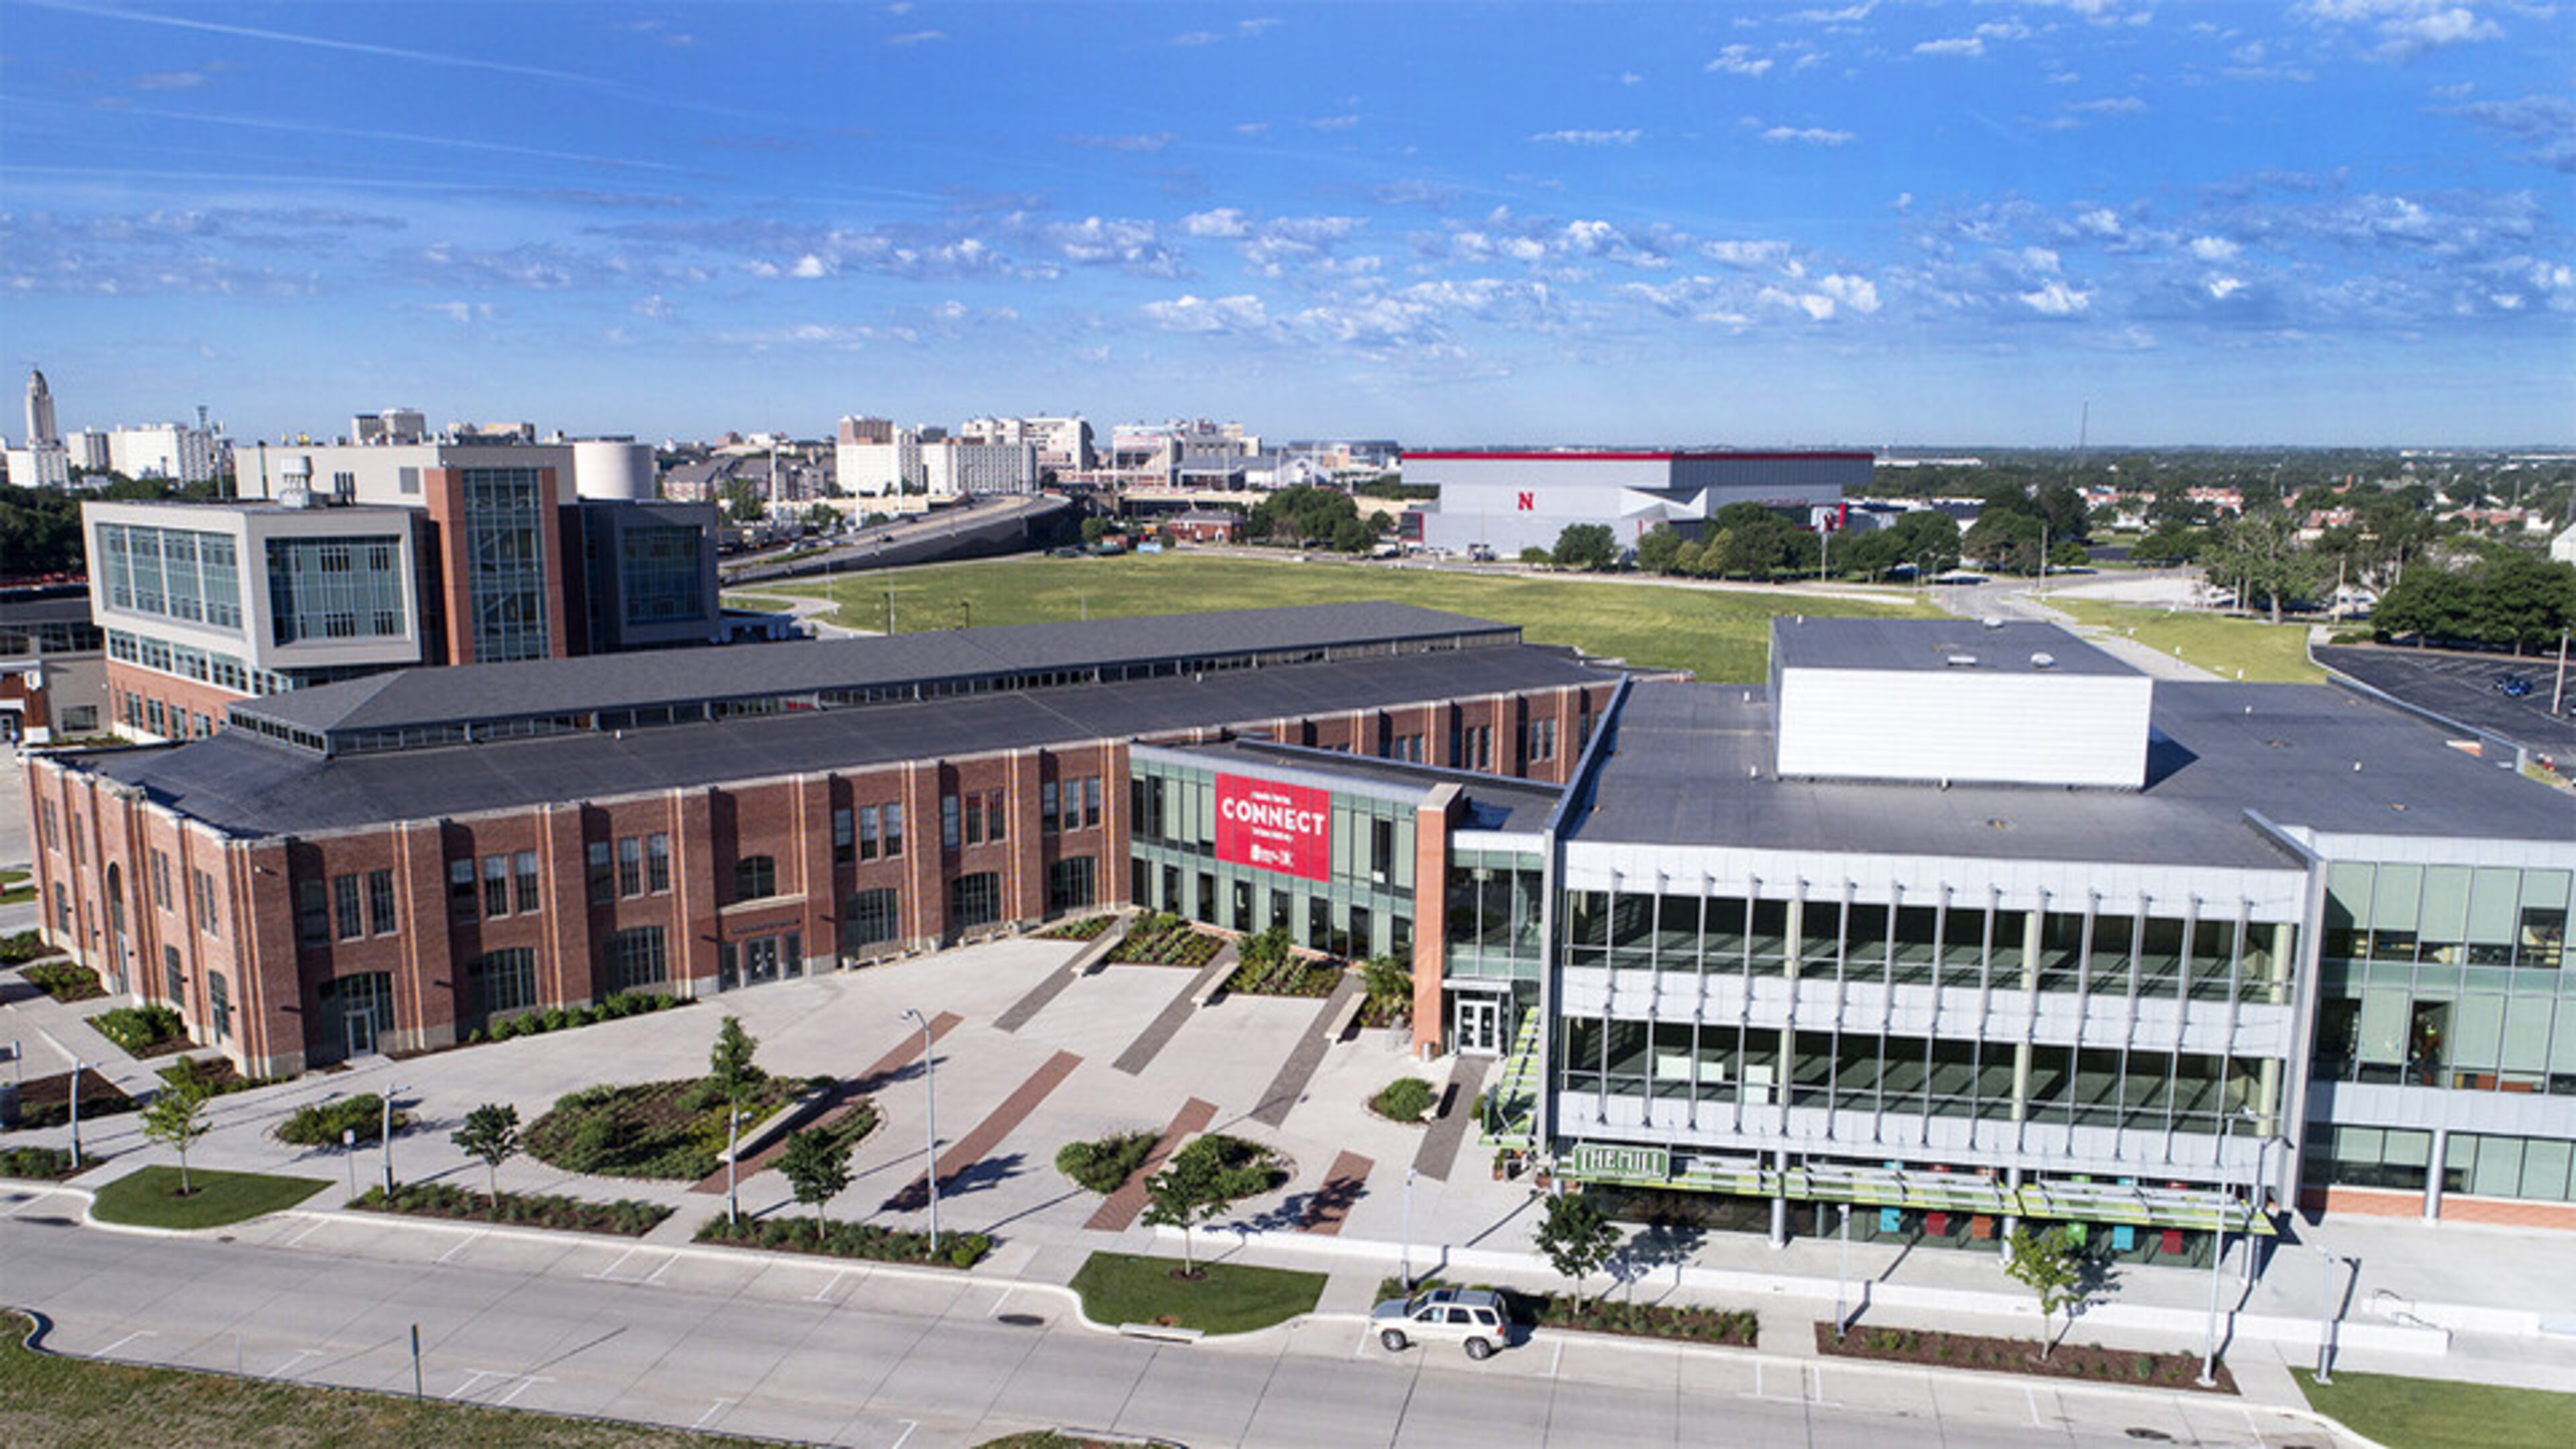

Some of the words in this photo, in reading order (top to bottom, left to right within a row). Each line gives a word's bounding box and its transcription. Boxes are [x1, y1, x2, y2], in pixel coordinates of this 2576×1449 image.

[1518, 491, 1534, 511] N
[1222, 798, 1325, 835] CONNECT
[1581, 1148, 1615, 1171] THE
[1619, 1150, 1662, 1176] MILL
